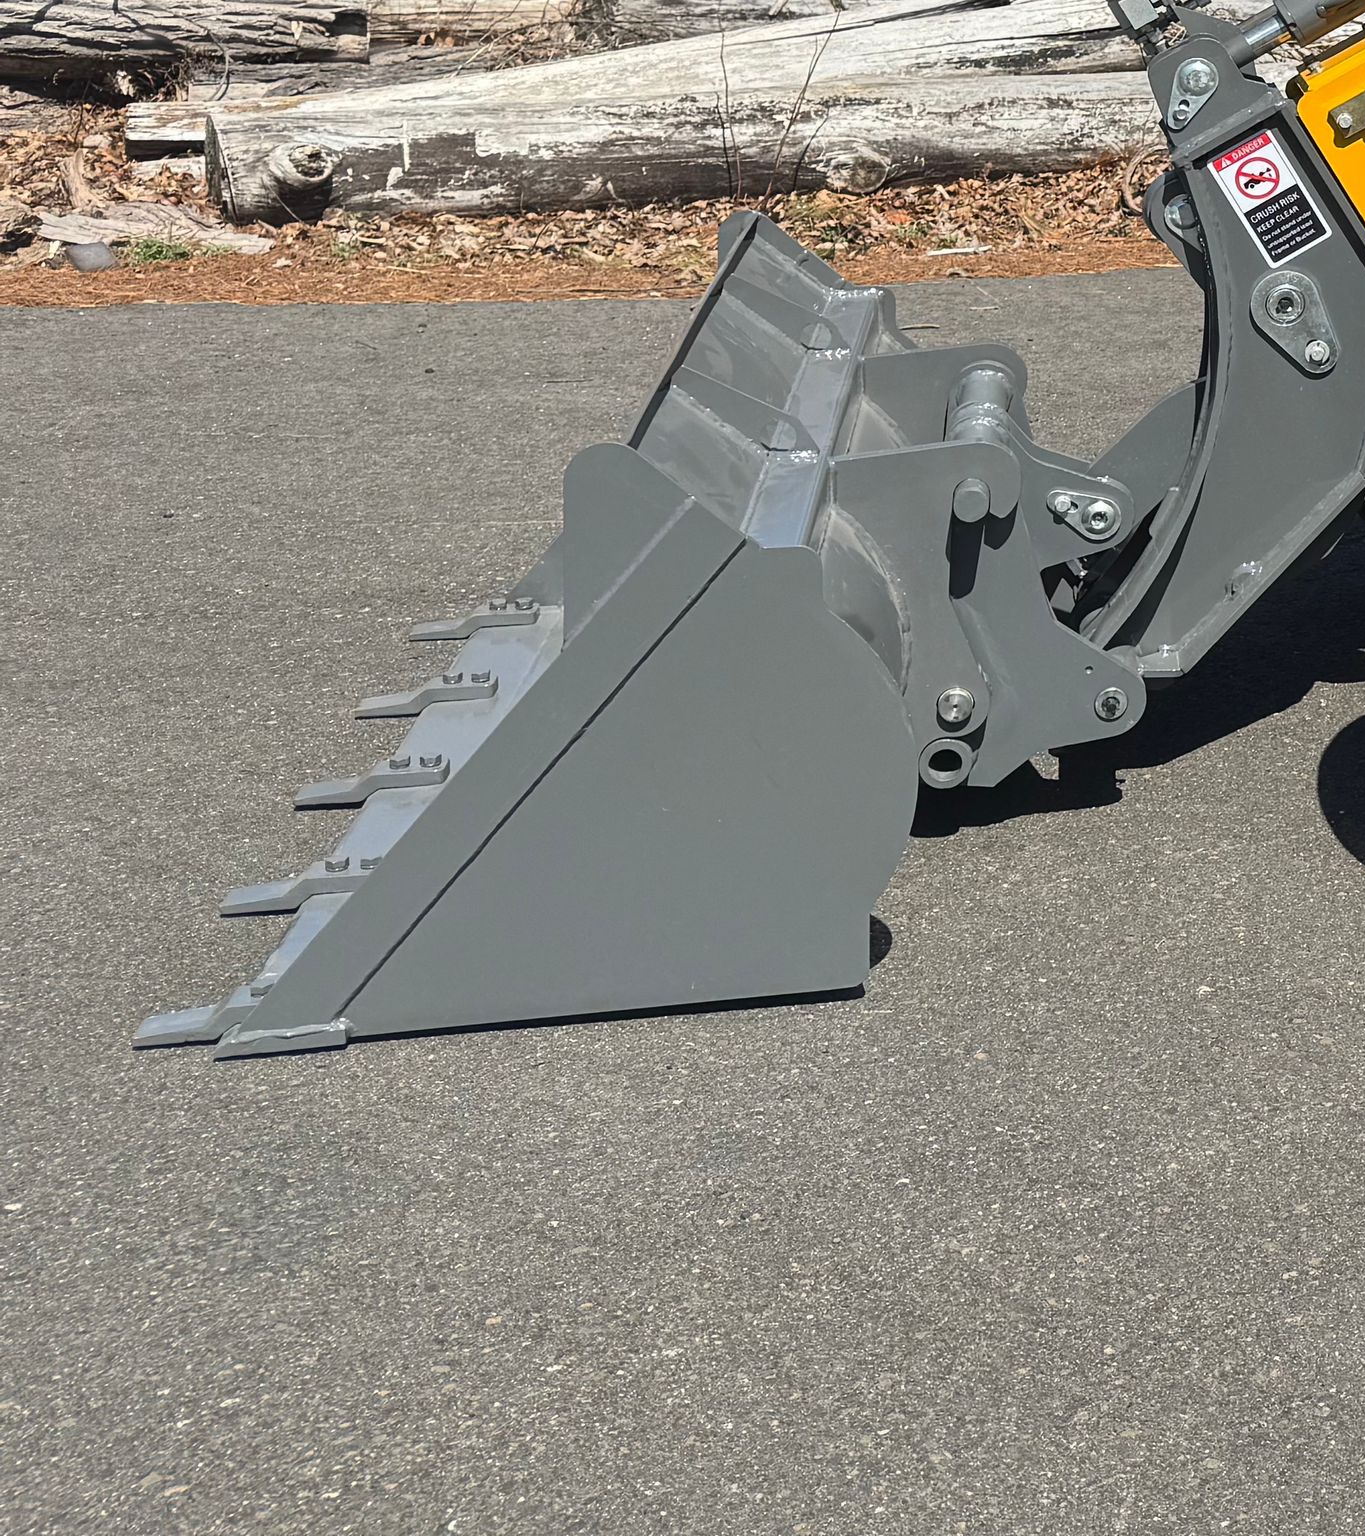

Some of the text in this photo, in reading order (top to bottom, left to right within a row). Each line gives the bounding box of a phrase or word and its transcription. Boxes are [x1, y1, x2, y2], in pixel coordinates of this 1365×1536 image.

[1231, 137, 1265, 161] DANGER
[1250, 191, 1301, 224] CRUSH RISK
[1256, 206, 1300, 233] KEEP CLEAR
